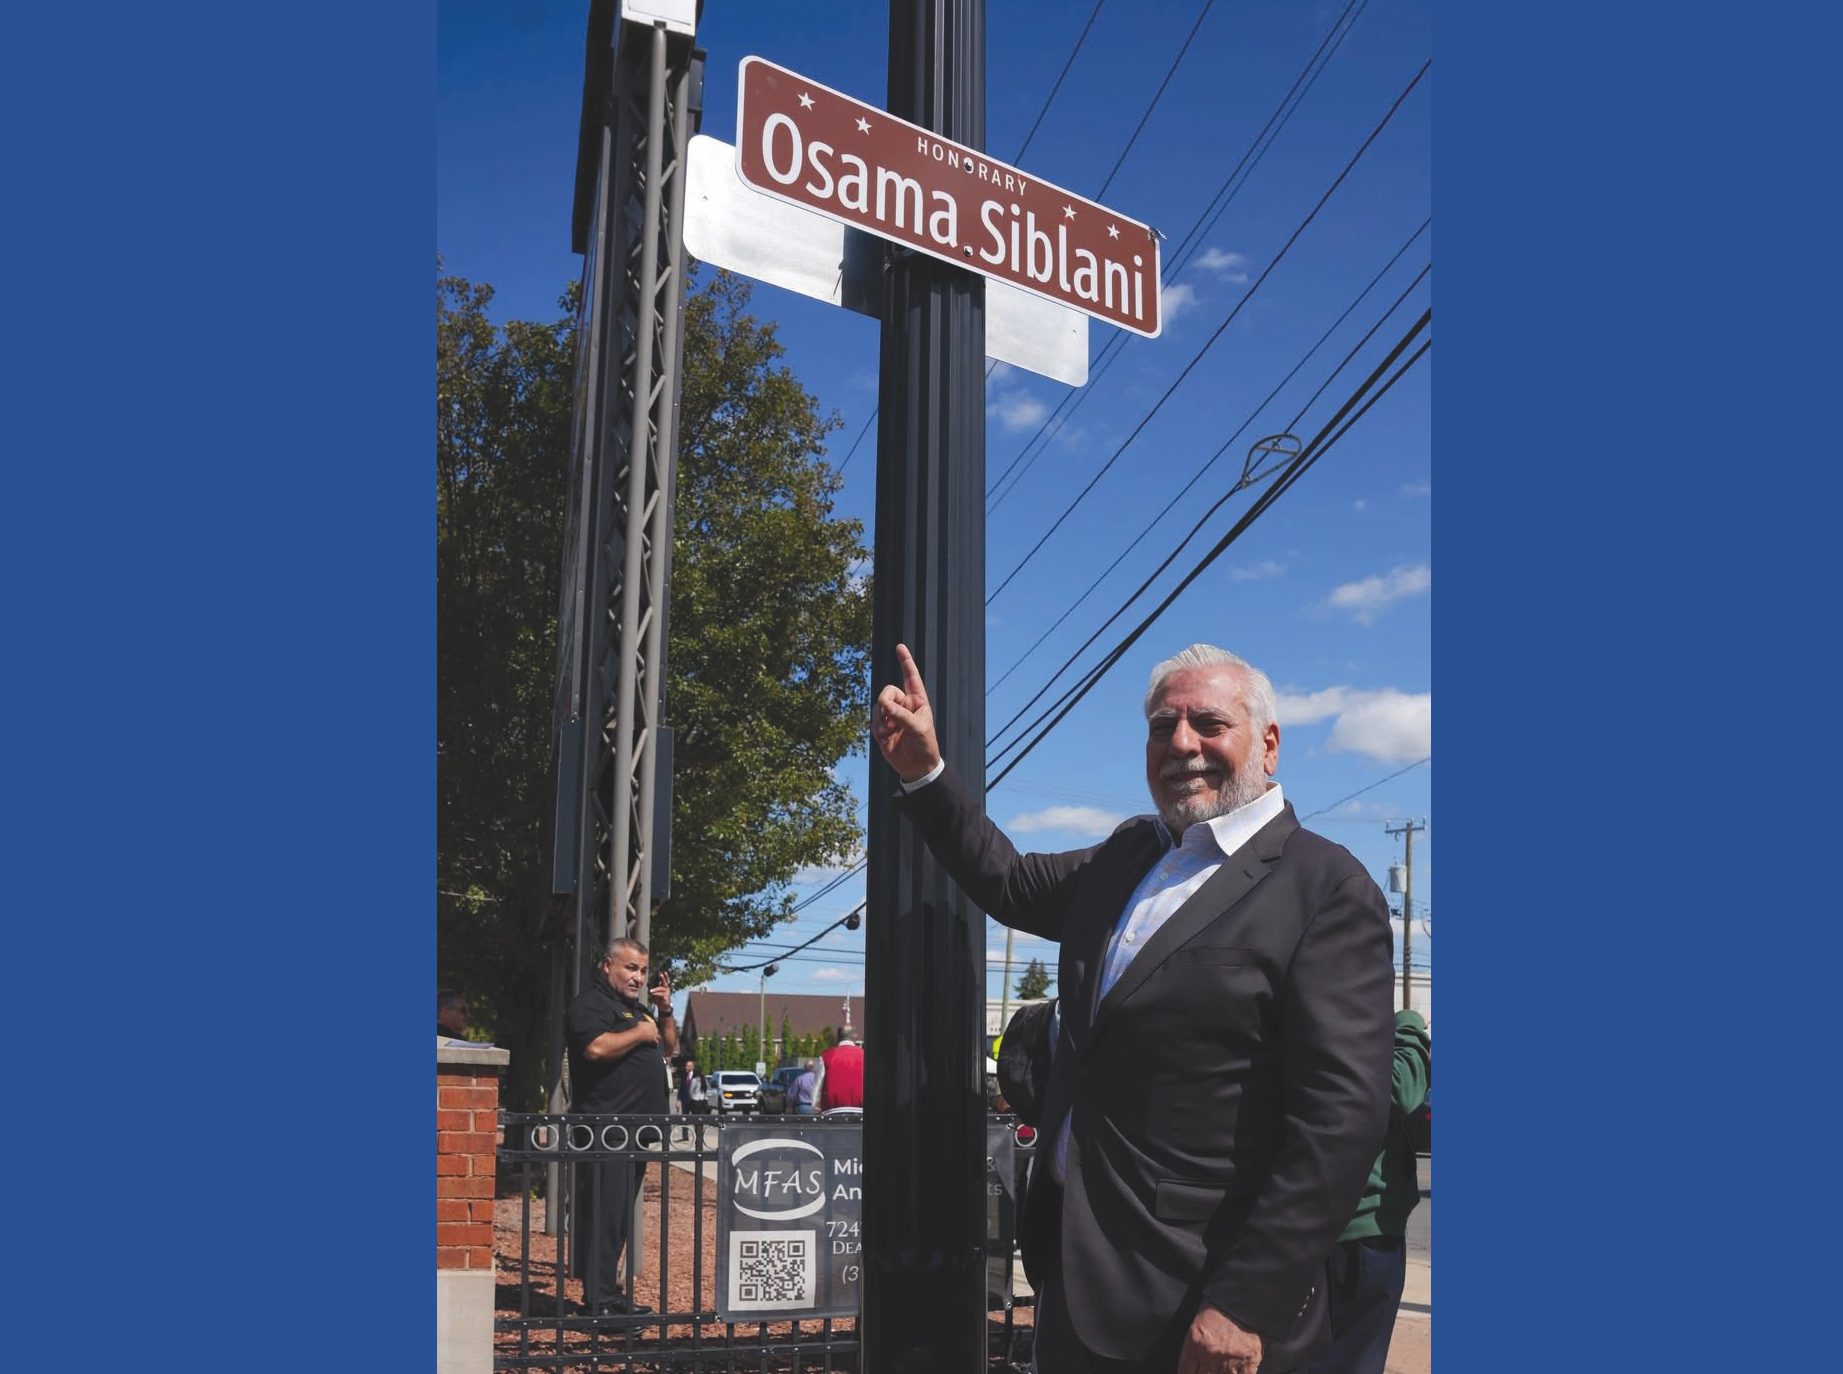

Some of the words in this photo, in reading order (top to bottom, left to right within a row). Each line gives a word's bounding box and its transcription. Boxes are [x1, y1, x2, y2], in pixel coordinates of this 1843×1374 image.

[918, 136, 1028, 197] HONORARY
[762, 112, 959, 250] Osama
[979, 200, 1144, 321] Siblani
[734, 1169, 822, 1197] MFAS
[826, 1220, 862, 1238] 724
